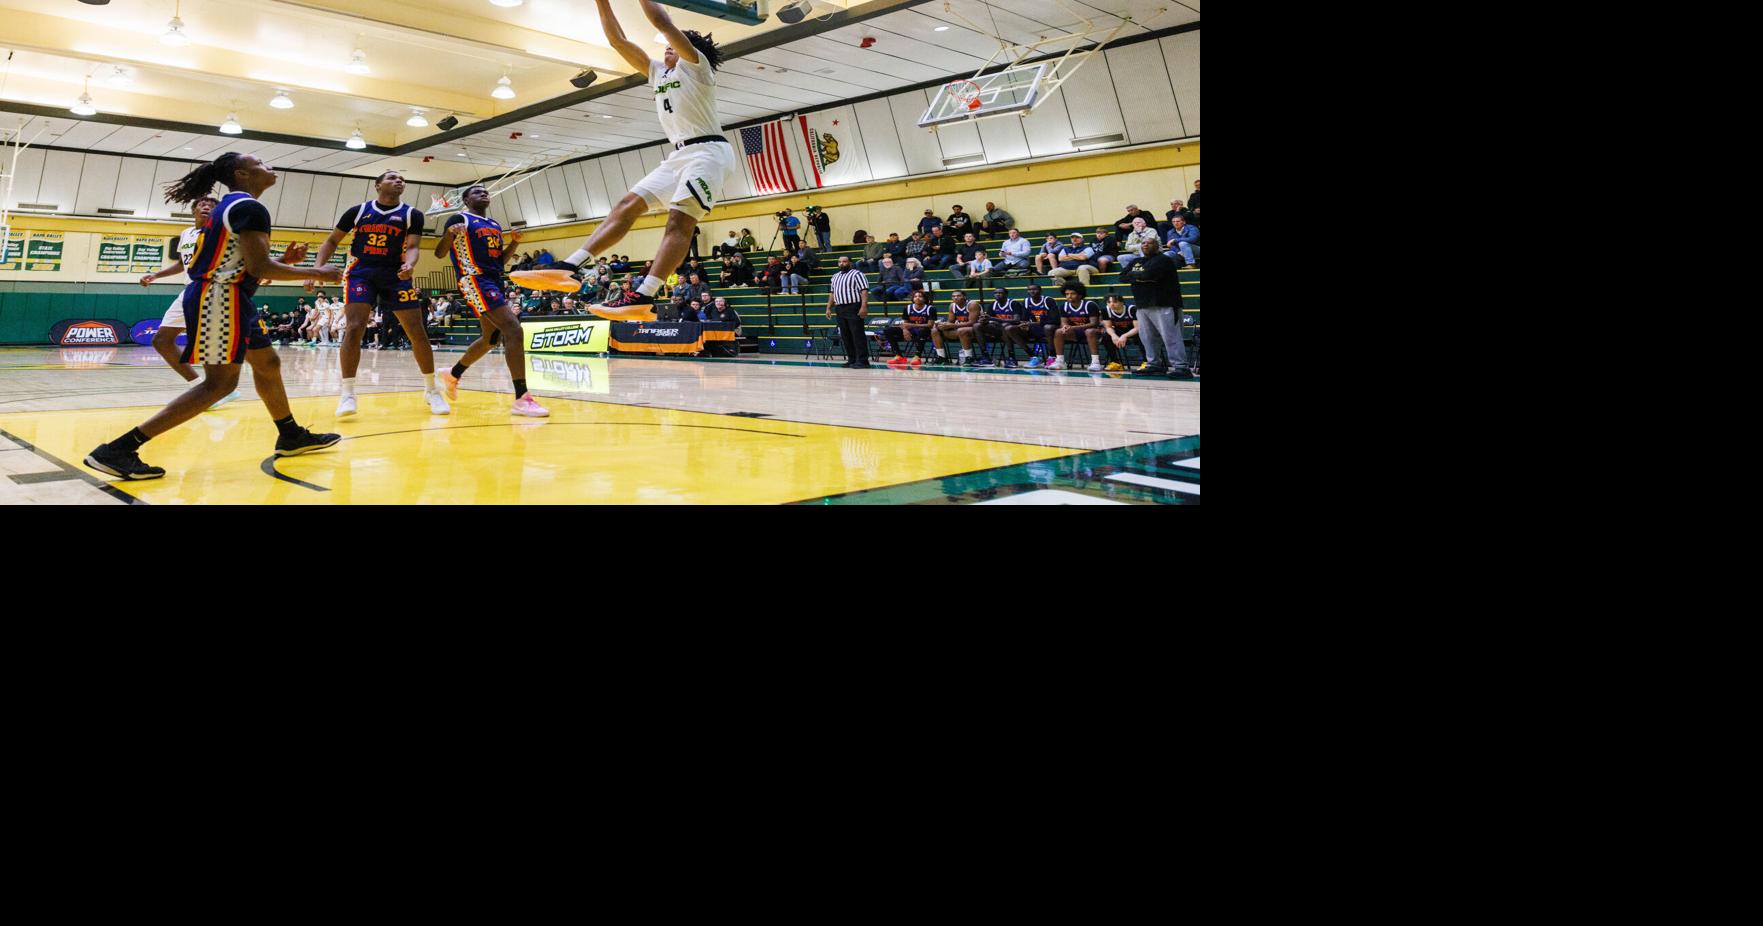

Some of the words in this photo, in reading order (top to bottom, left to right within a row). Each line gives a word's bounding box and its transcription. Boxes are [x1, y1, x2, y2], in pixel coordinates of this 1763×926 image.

[663, 98, 673, 113] 4
[359, 223, 401, 237] TRINITY
[367, 233, 387, 247] 32
[399, 289, 418, 303] 32
[66, 327, 114, 339] POWER
[530, 326, 595, 350] STORM
